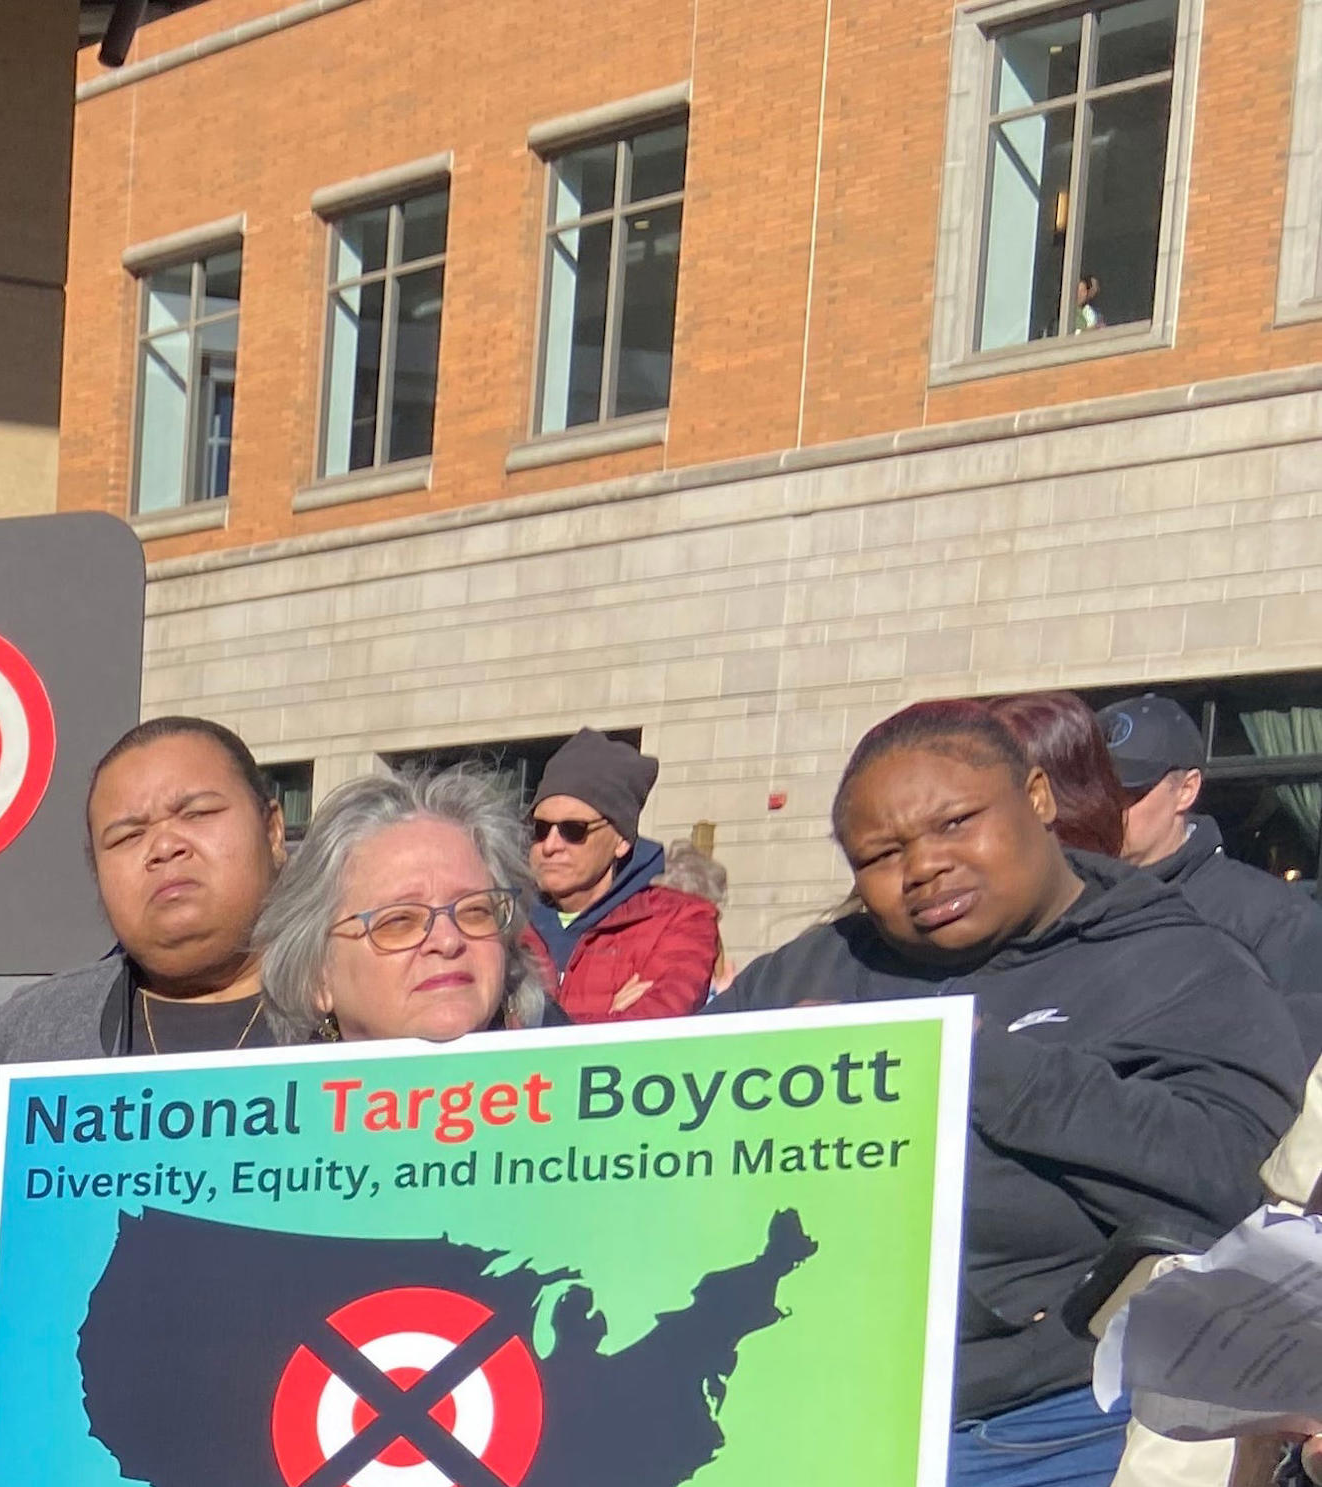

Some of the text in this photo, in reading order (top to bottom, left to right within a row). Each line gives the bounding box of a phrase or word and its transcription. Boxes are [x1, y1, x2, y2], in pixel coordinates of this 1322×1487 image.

[24, 1049, 902, 1145] National Target Boycott
[26, 1135, 911, 1204] Diversity, Equity, and Inclusion Matter
